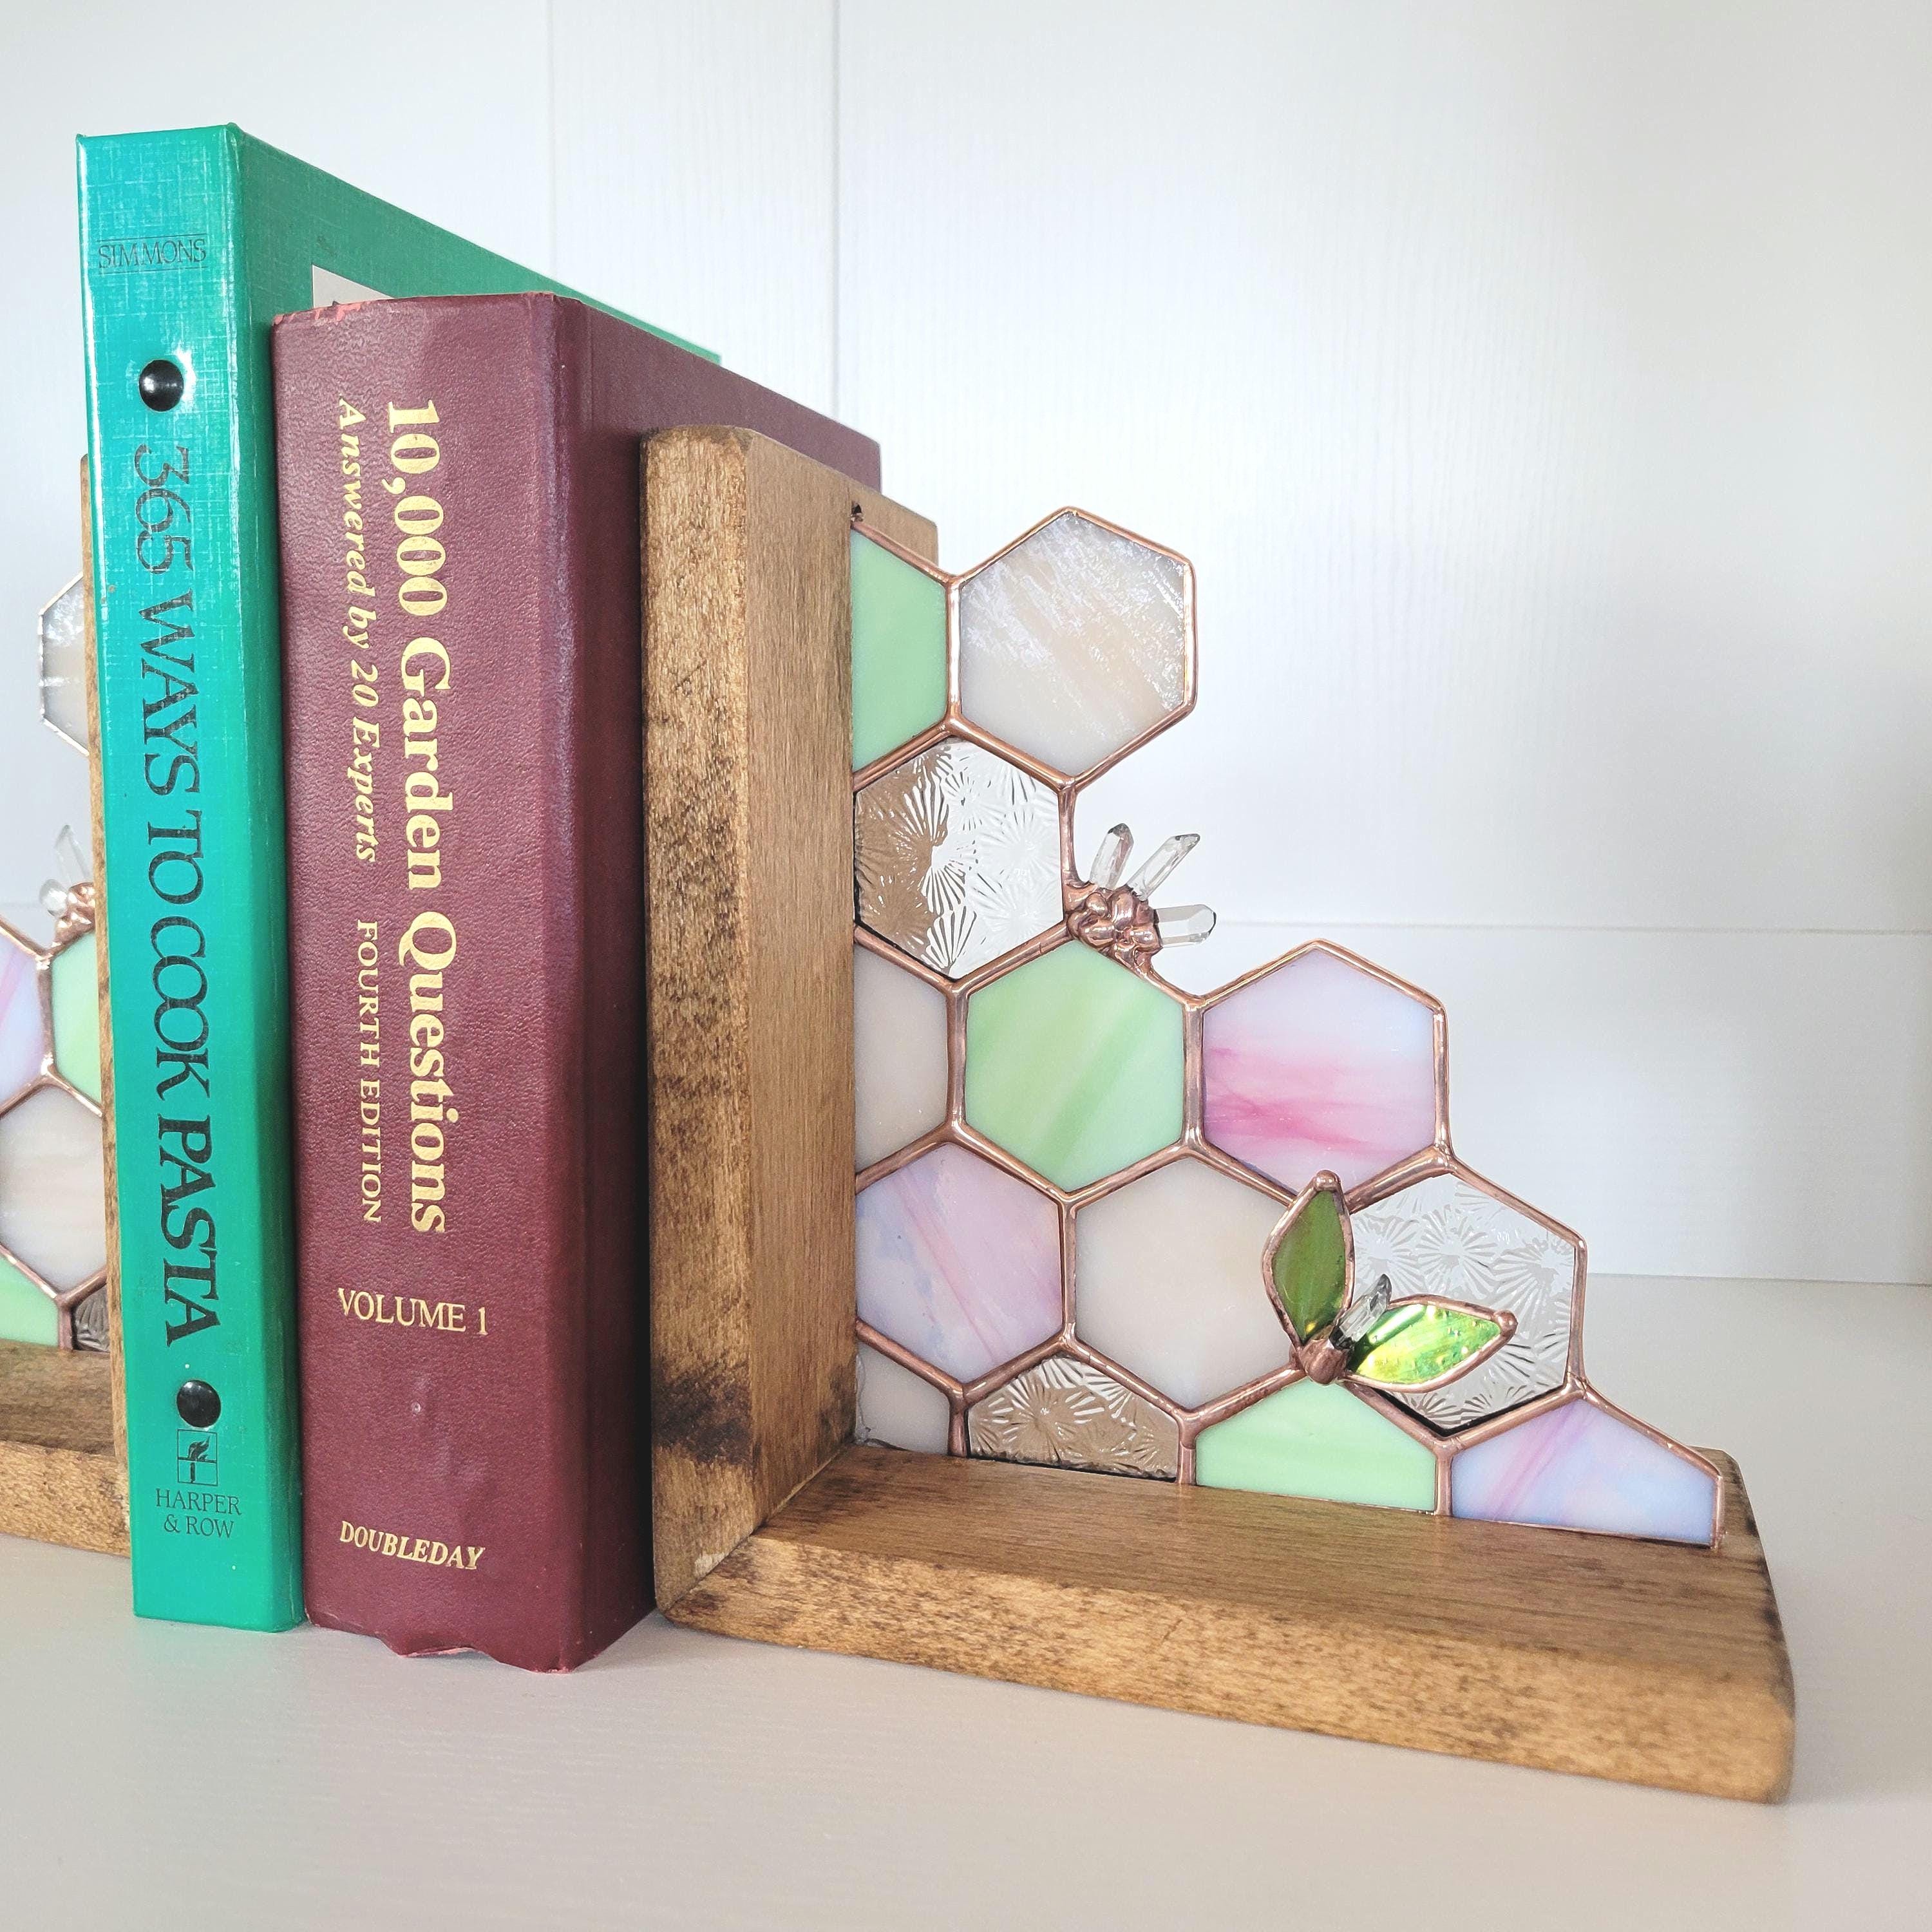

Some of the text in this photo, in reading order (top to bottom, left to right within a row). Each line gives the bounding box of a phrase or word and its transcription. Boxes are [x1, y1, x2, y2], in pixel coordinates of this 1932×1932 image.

[98, 238, 207, 269] SIMMONS
[339, 395, 381, 864] Answered by 20 Experts
[382, 400, 457, 1233] 10,000 Garden Questions
[134, 444, 221, 1347] 365 WAYS TO COOK PASTA
[355, 920, 381, 1223] FOURTH EDITION
[337, 1288, 488, 1336] VOLUME 1
[155, 1488, 242, 1515] HARPER
[163, 1516, 234, 1539] & ROW
[340, 1521, 486, 1570] DOUBLEDAY
